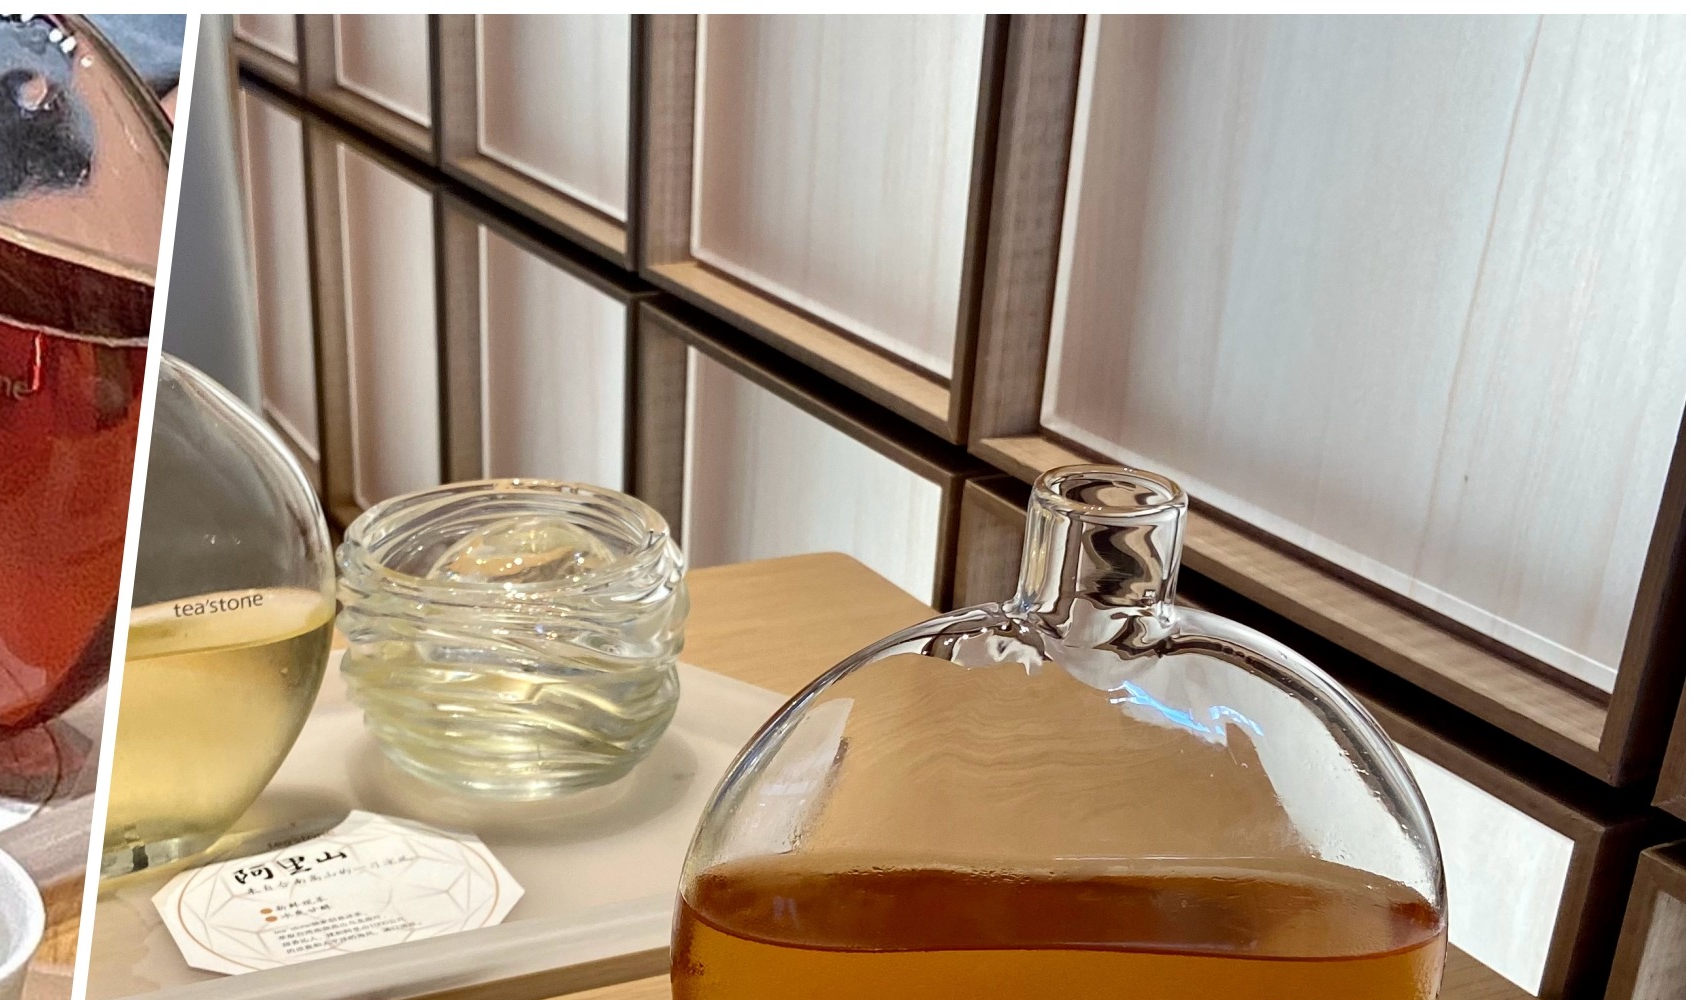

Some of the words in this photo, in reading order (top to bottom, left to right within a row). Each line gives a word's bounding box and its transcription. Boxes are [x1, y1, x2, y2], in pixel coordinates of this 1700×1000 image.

[173, 592, 264, 618] tea'stone
[233, 848, 348, 885] 阿里山
